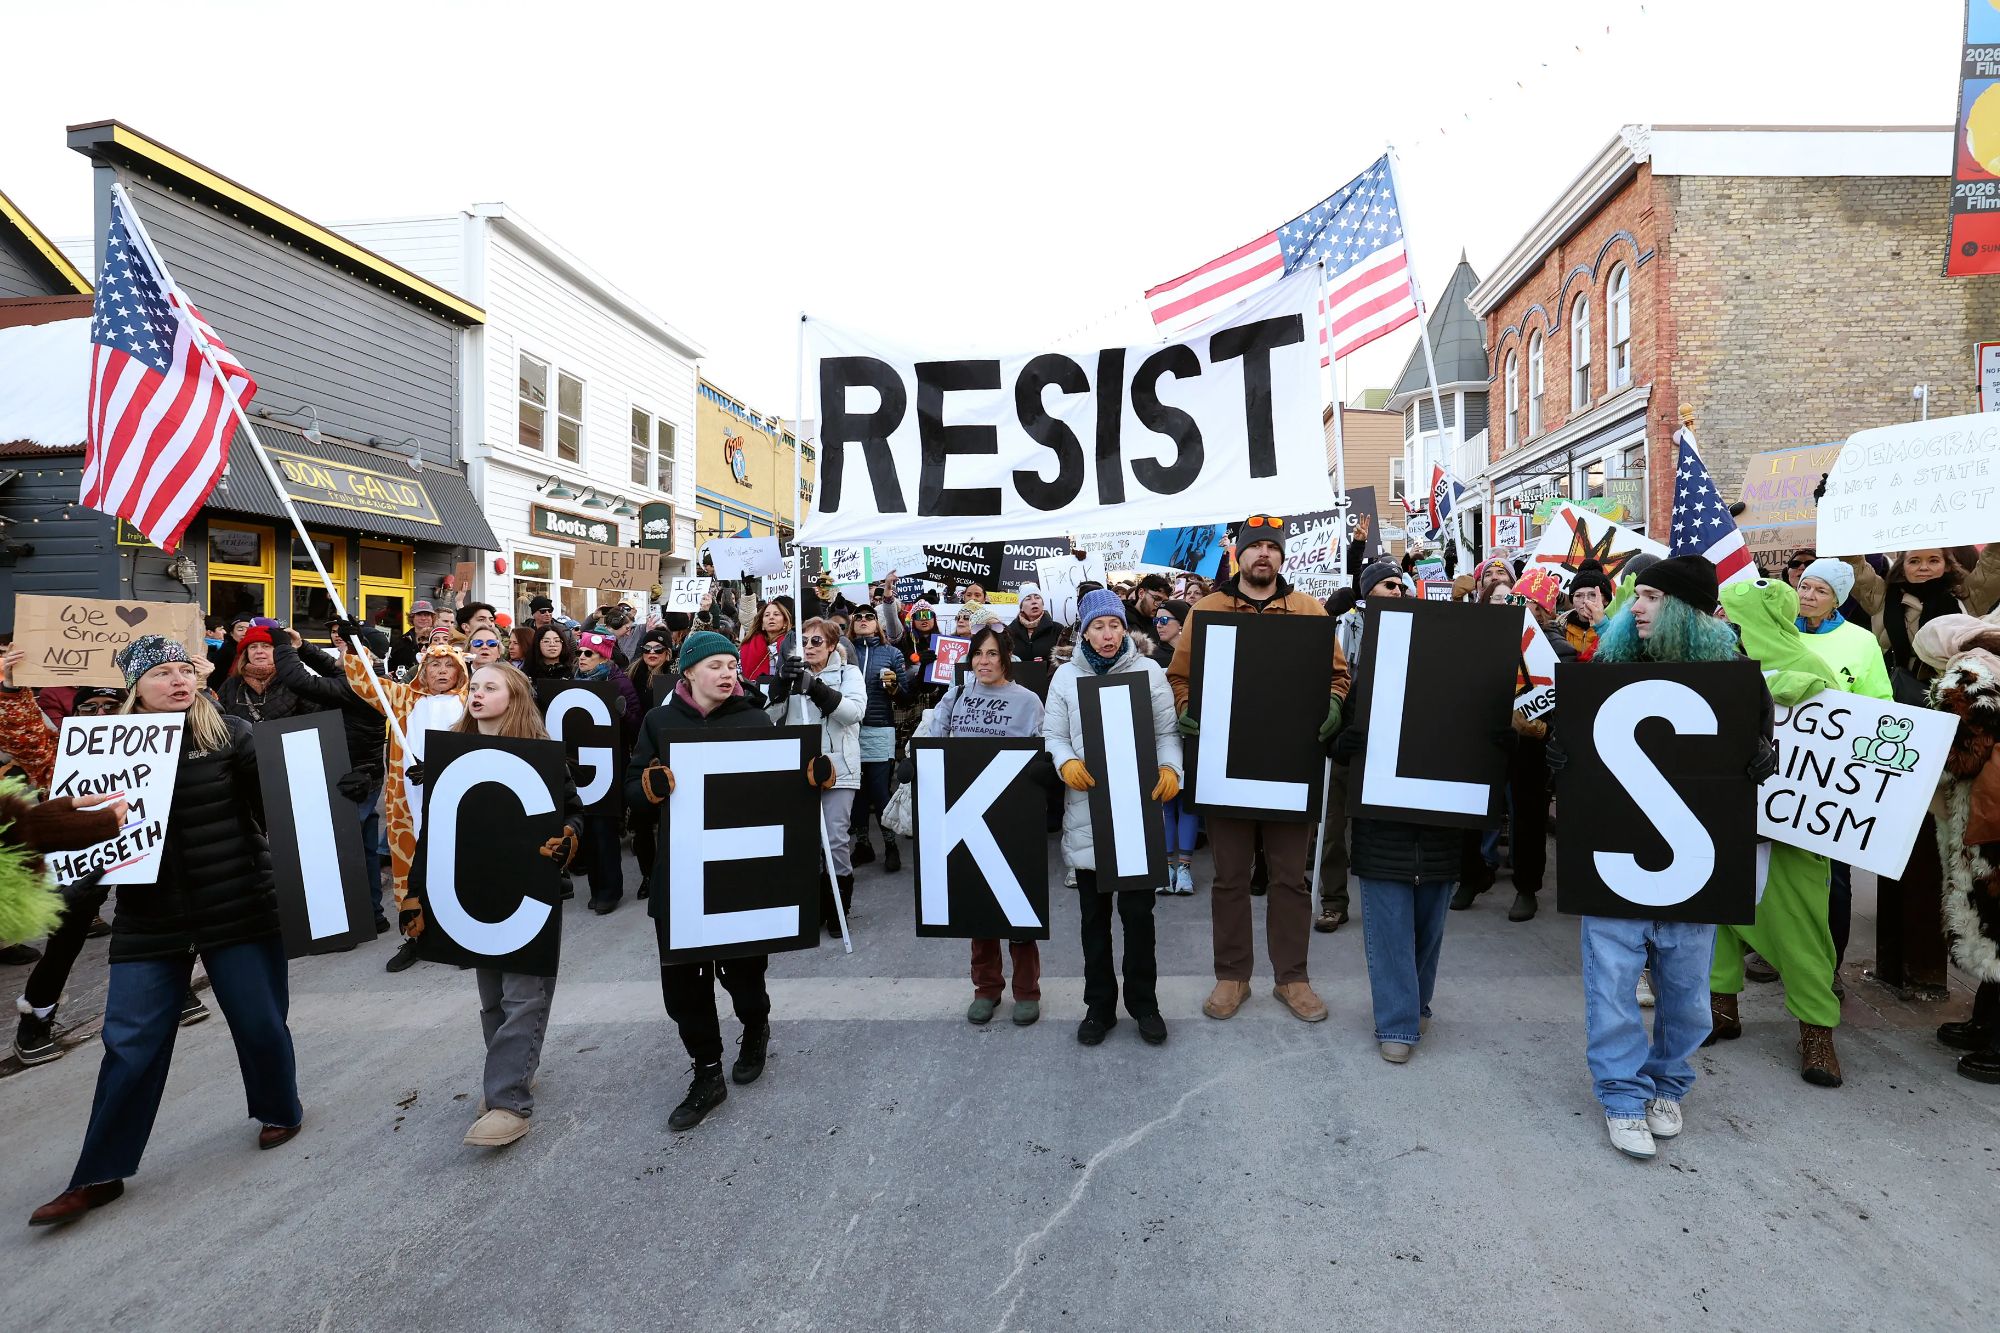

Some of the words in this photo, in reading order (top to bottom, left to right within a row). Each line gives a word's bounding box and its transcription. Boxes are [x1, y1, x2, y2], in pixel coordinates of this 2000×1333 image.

[1955, 182, 1995, 197] 2026
[818, 313, 1305, 517] RESIST
[1839, 426, 2000, 474] DEMOCRAC
[1914, 458, 1991, 486] STATE
[285, 461, 338, 491] DON
[347, 474, 418, 507] GALLO
[1612, 481, 1638, 492] AURA
[1616, 493, 1634, 505] SPA
[1891, 498, 1918, 515] AN
[1930, 487, 1995, 514] ACT
[545, 511, 587, 537] Roots
[1289, 522, 1300, 536] &
[1872, 520, 1950, 541] #ICEOUT
[1003, 544, 1064, 557] OMOTING
[588, 549, 619, 568] ICE
[626, 551, 659, 572] OUT
[926, 555, 991, 576] PPONENTS
[1013, 560, 1036, 572] LIES
[674, 579, 705, 592] ICE
[765, 584, 789, 596] TRUMP
[897, 585, 913, 593] NOT
[1306, 577, 1328, 590] KEEP
[676, 592, 701, 605] OUT
[43, 646, 105, 668] NOT
[986, 699, 1009, 711] ICE
[981, 709, 996, 717] THE
[983, 715, 1013, 726] OUT
[959, 726, 1006, 737] MINNEAPOLIS
[65, 724, 182, 757] DEPORT
[544, 688, 613, 806] G
[1765, 789, 1877, 851] CISM
[52, 820, 163, 882] HEGSETH
